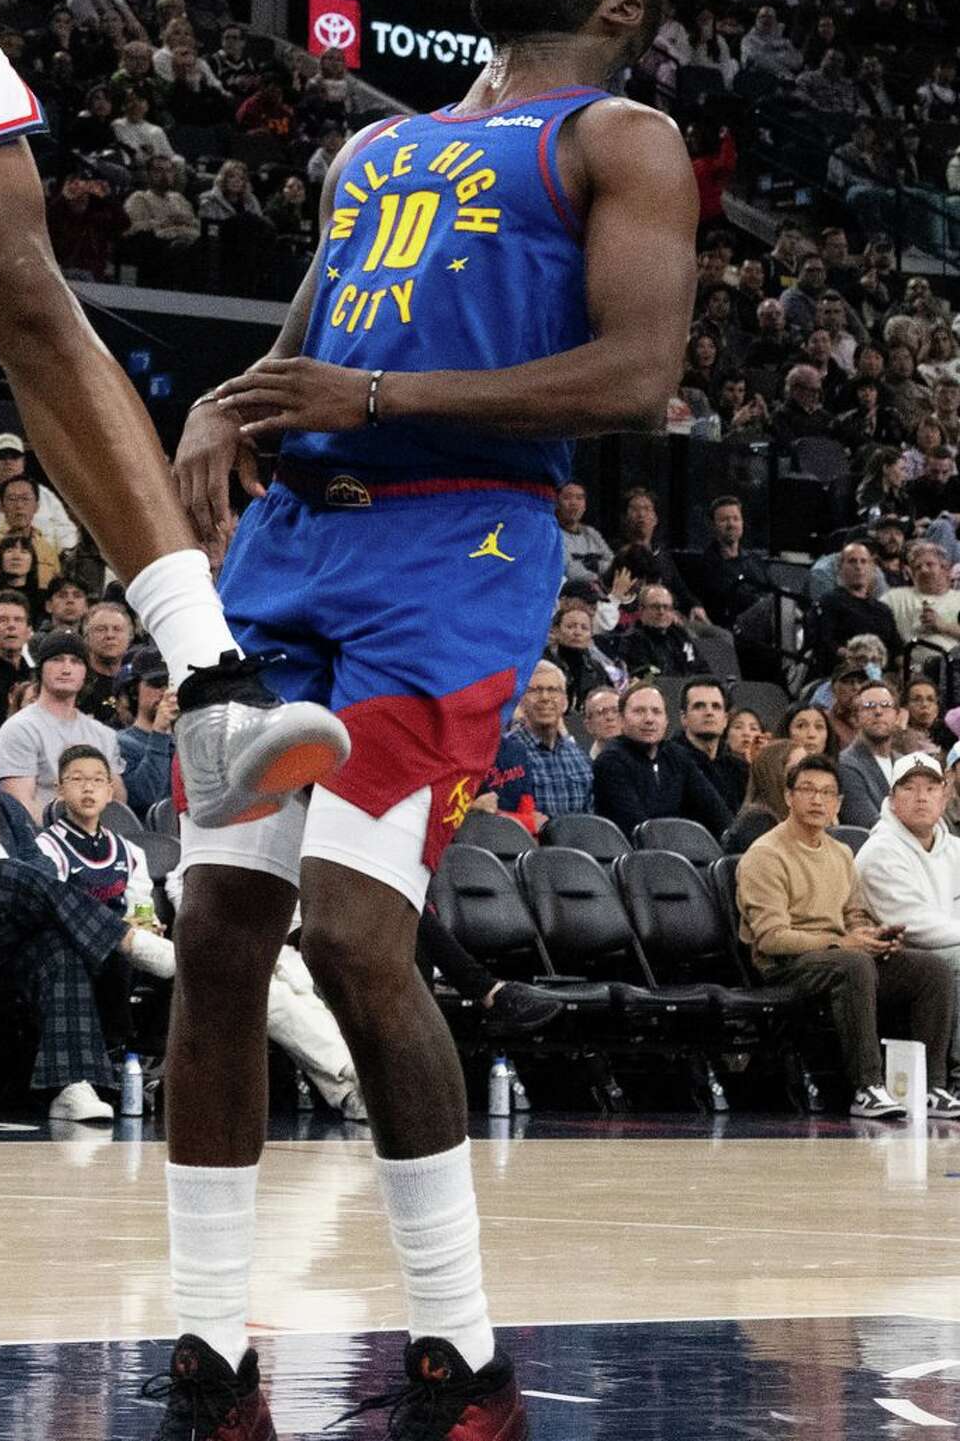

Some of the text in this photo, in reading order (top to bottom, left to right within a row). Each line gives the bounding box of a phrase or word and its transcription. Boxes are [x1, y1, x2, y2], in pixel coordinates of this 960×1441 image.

[371, 21, 494, 66] TOYOTA
[485, 115, 544, 129] ibotta
[329, 140, 502, 241] MILE HIGH
[362, 190, 441, 272] 10
[330, 279, 415, 334] CITY
